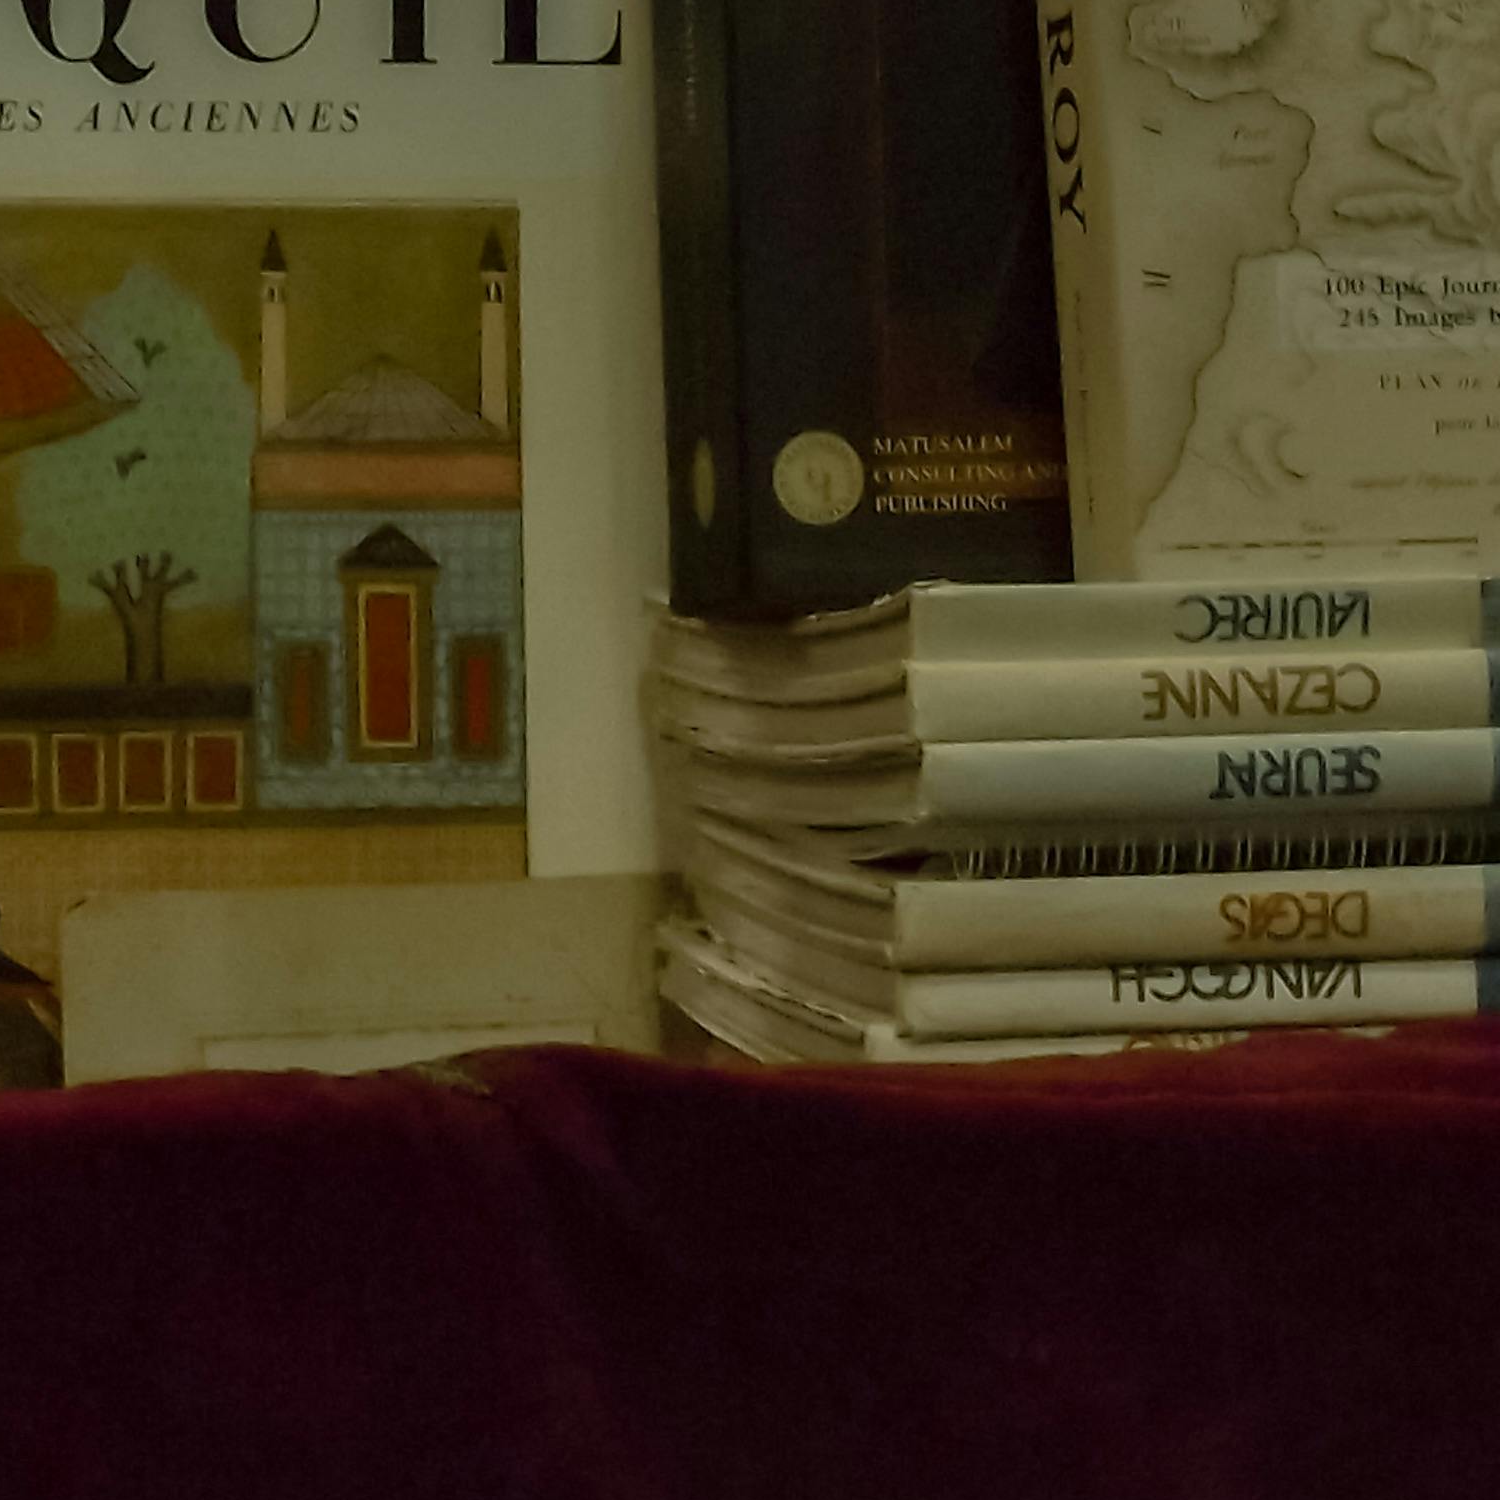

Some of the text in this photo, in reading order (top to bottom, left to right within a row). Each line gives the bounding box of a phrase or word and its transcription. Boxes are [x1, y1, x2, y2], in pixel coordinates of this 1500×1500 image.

[74, 99, 364, 136] ANCIENNES
[1393, 305, 1477, 329] Images
[1174, 594, 1373, 644] LAUTREC
[1140, 661, 1383, 722] CEZANNE
[1209, 745, 1383, 802] SEURAT
[1219, 889, 1371, 941] DEGAS
